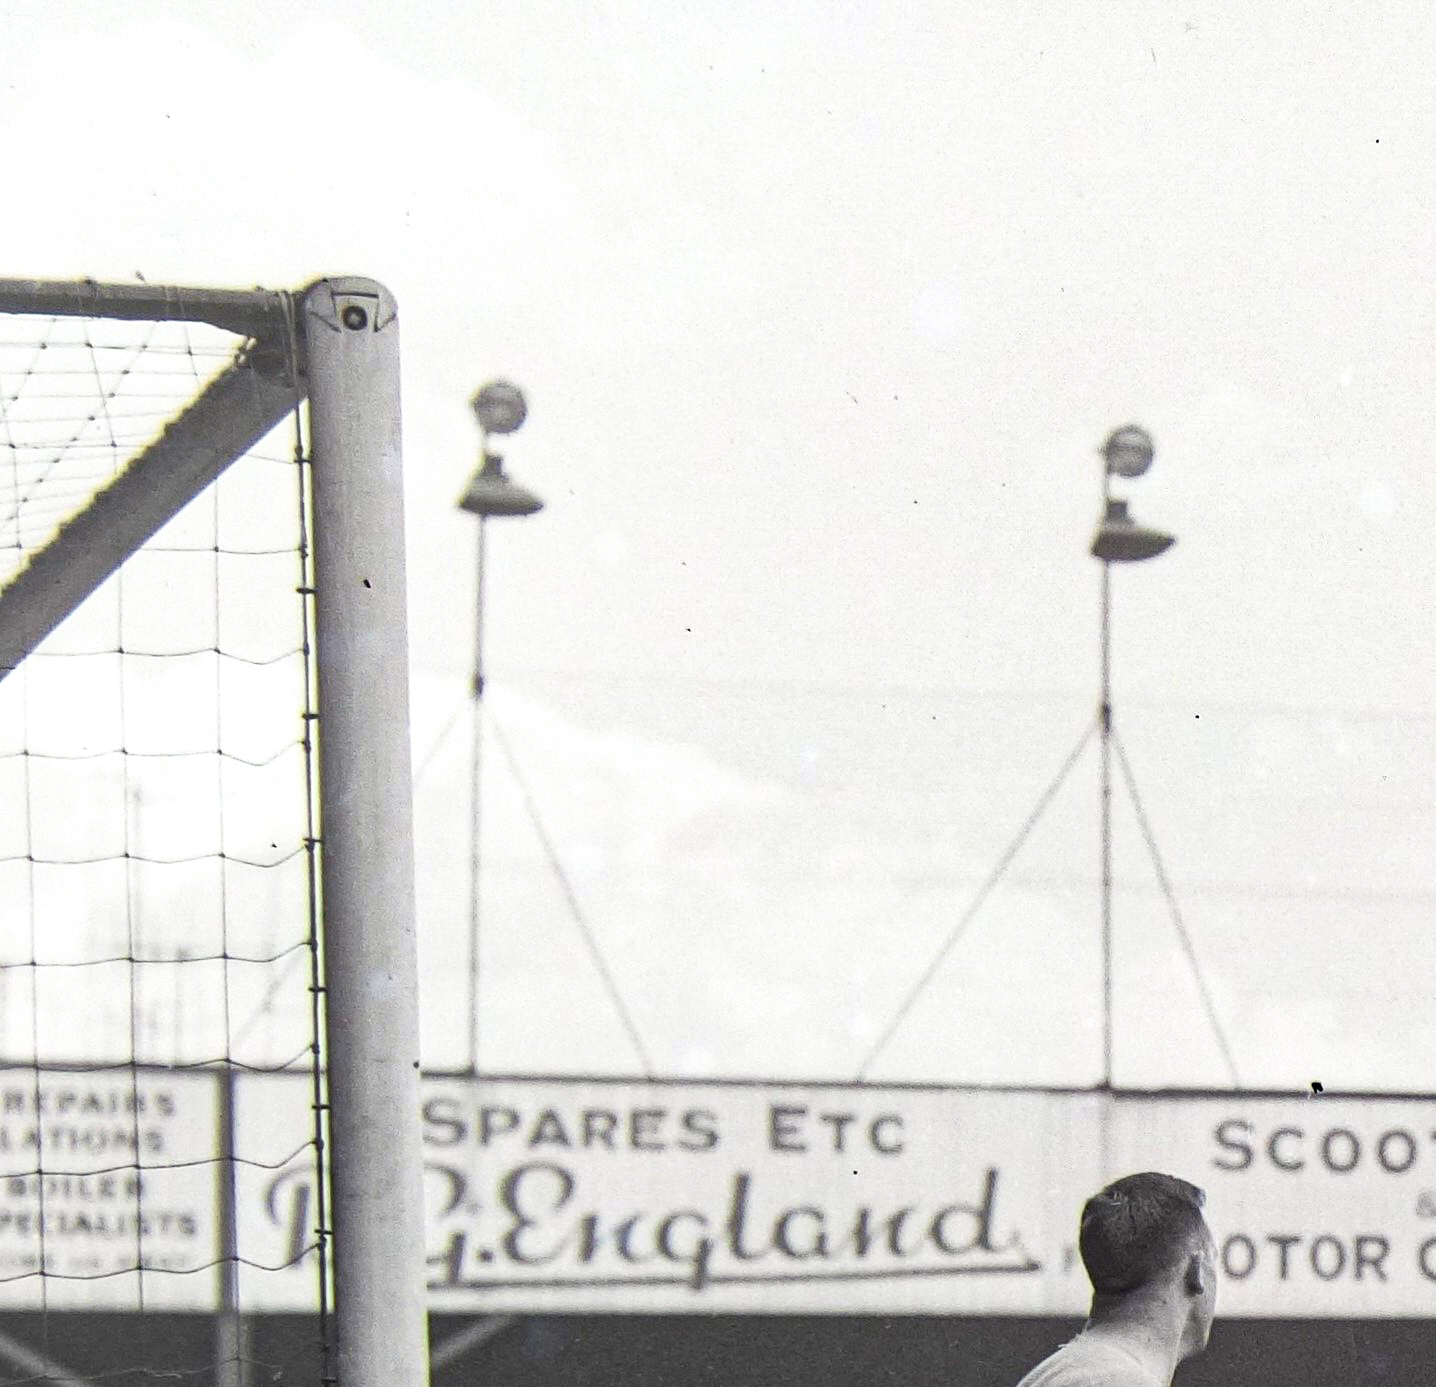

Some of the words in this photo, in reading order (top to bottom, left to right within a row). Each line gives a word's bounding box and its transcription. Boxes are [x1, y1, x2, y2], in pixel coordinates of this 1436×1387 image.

[4, 1091, 174, 1117] REPAIRS
[422, 1097, 720, 1152] SPARES
[768, 1103, 904, 1154] ETC
[1219, 1234, 1391, 1283] OTOR
